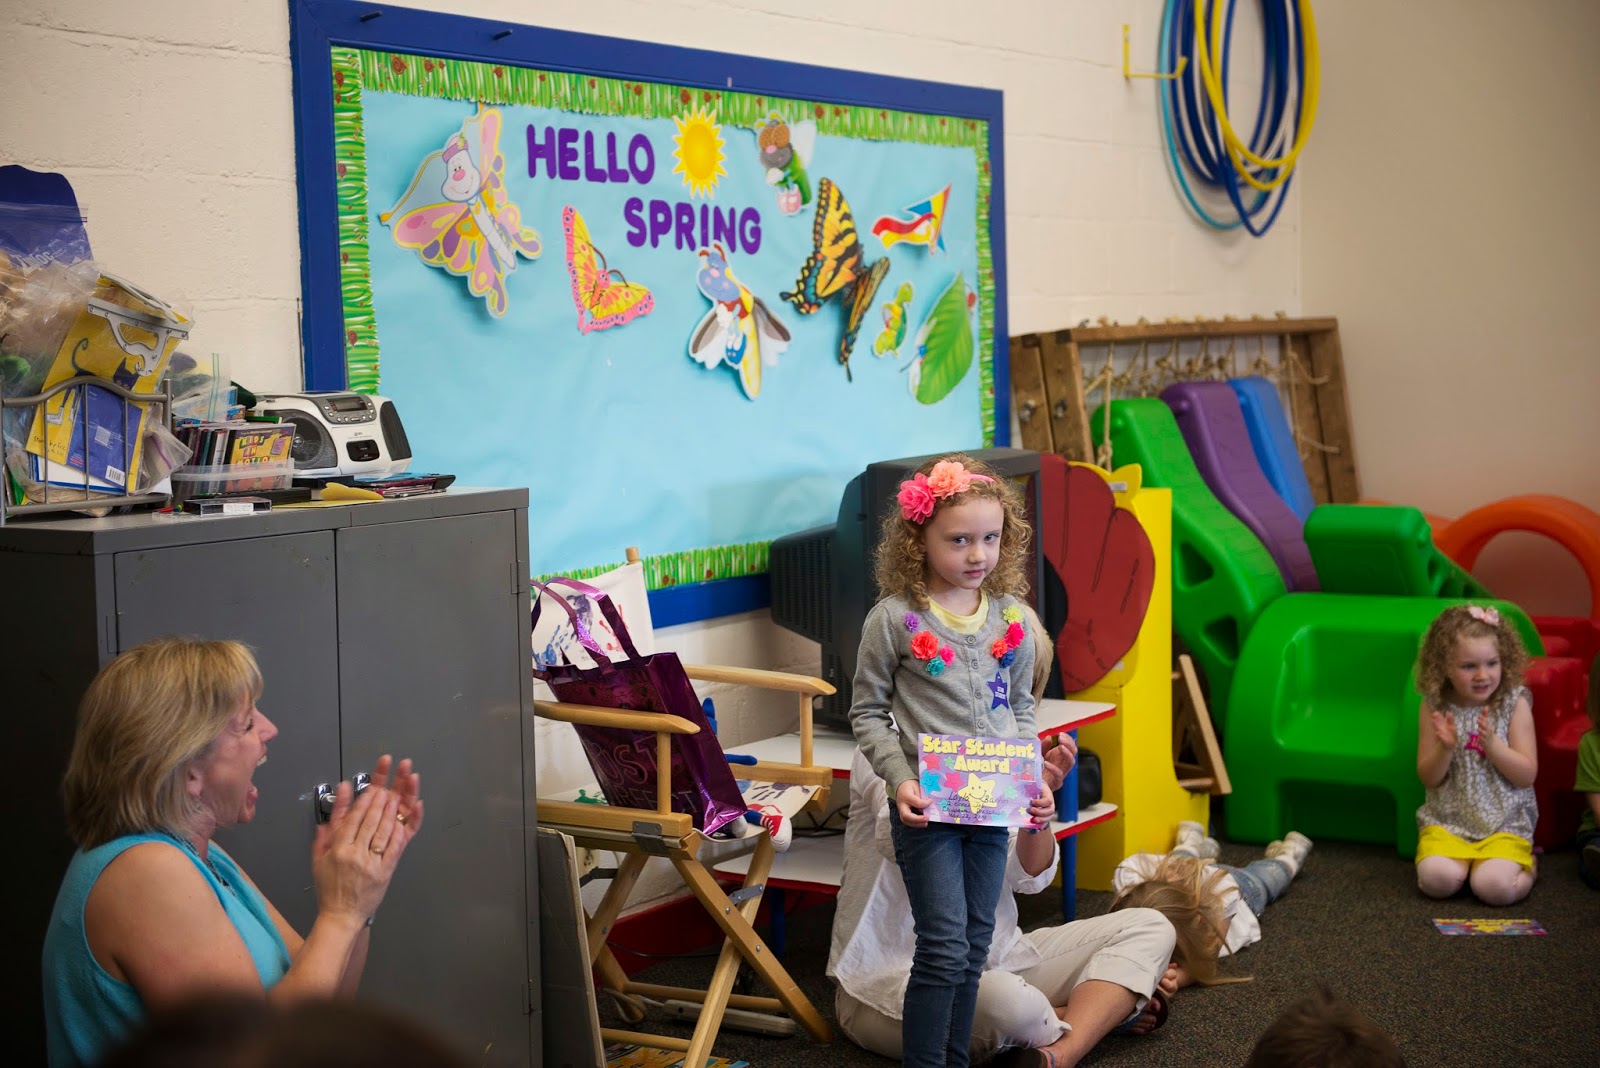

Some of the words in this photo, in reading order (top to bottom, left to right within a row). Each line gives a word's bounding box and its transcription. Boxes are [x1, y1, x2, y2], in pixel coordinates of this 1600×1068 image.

[526, 124, 655, 185] HELLO
[624, 197, 761, 255] SPRING
[240, 436, 264, 447] KIDS
[246, 446, 256, 455] IN
[237, 457, 274, 465] MOTION
[922, 736, 961, 753] Star
[965, 739, 1035, 759] Student
[954, 755, 1010, 774] Award
